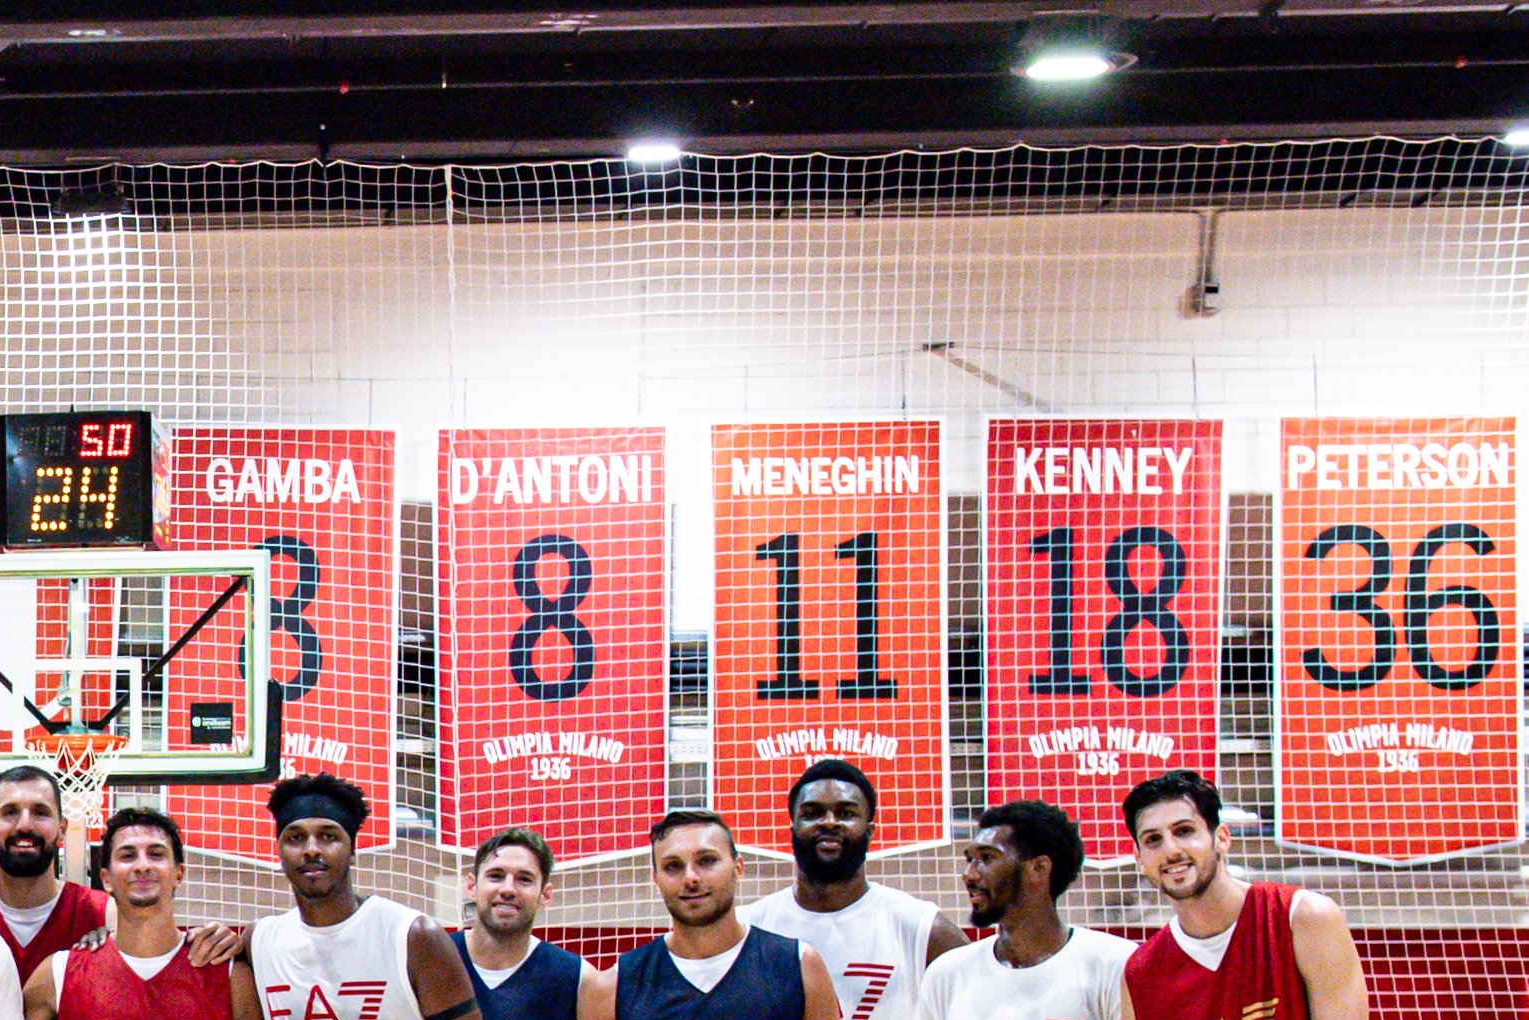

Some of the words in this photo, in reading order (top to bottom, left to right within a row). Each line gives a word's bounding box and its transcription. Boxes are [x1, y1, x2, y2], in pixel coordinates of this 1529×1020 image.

[80, 424, 131, 456] 50
[205, 458, 362, 504] GAMBA
[450, 455, 654, 505] D'ANTONI
[732, 455, 920, 496] MENEGHIN
[1015, 446, 1193, 495] KENNEY
[1287, 443, 1511, 490] PETERSON
[31, 466, 118, 531] 24
[238, 535, 324, 703] 8
[509, 533, 597, 702] 8
[755, 532, 899, 701] 11
[1028, 525, 1192, 698] 18
[1301, 523, 1500, 692] 36
[284, 732, 348, 765] MILANO
[483, 731, 552, 764] OLIMPIA
[559, 731, 624, 763] MILANO
[756, 728, 827, 760] OLIMPIA
[833, 728, 898, 760] MILANO
[1028, 726, 1101, 758] OLIMPIA
[1107, 726, 1174, 759] MILANO
[1327, 723, 1398, 756] OLIMPIA
[1406, 723, 1474, 756] MILANO
[530, 757, 572, 780] 1936
[1078, 752, 1119, 775] 1936
[1377, 750, 1419, 773] 1936
